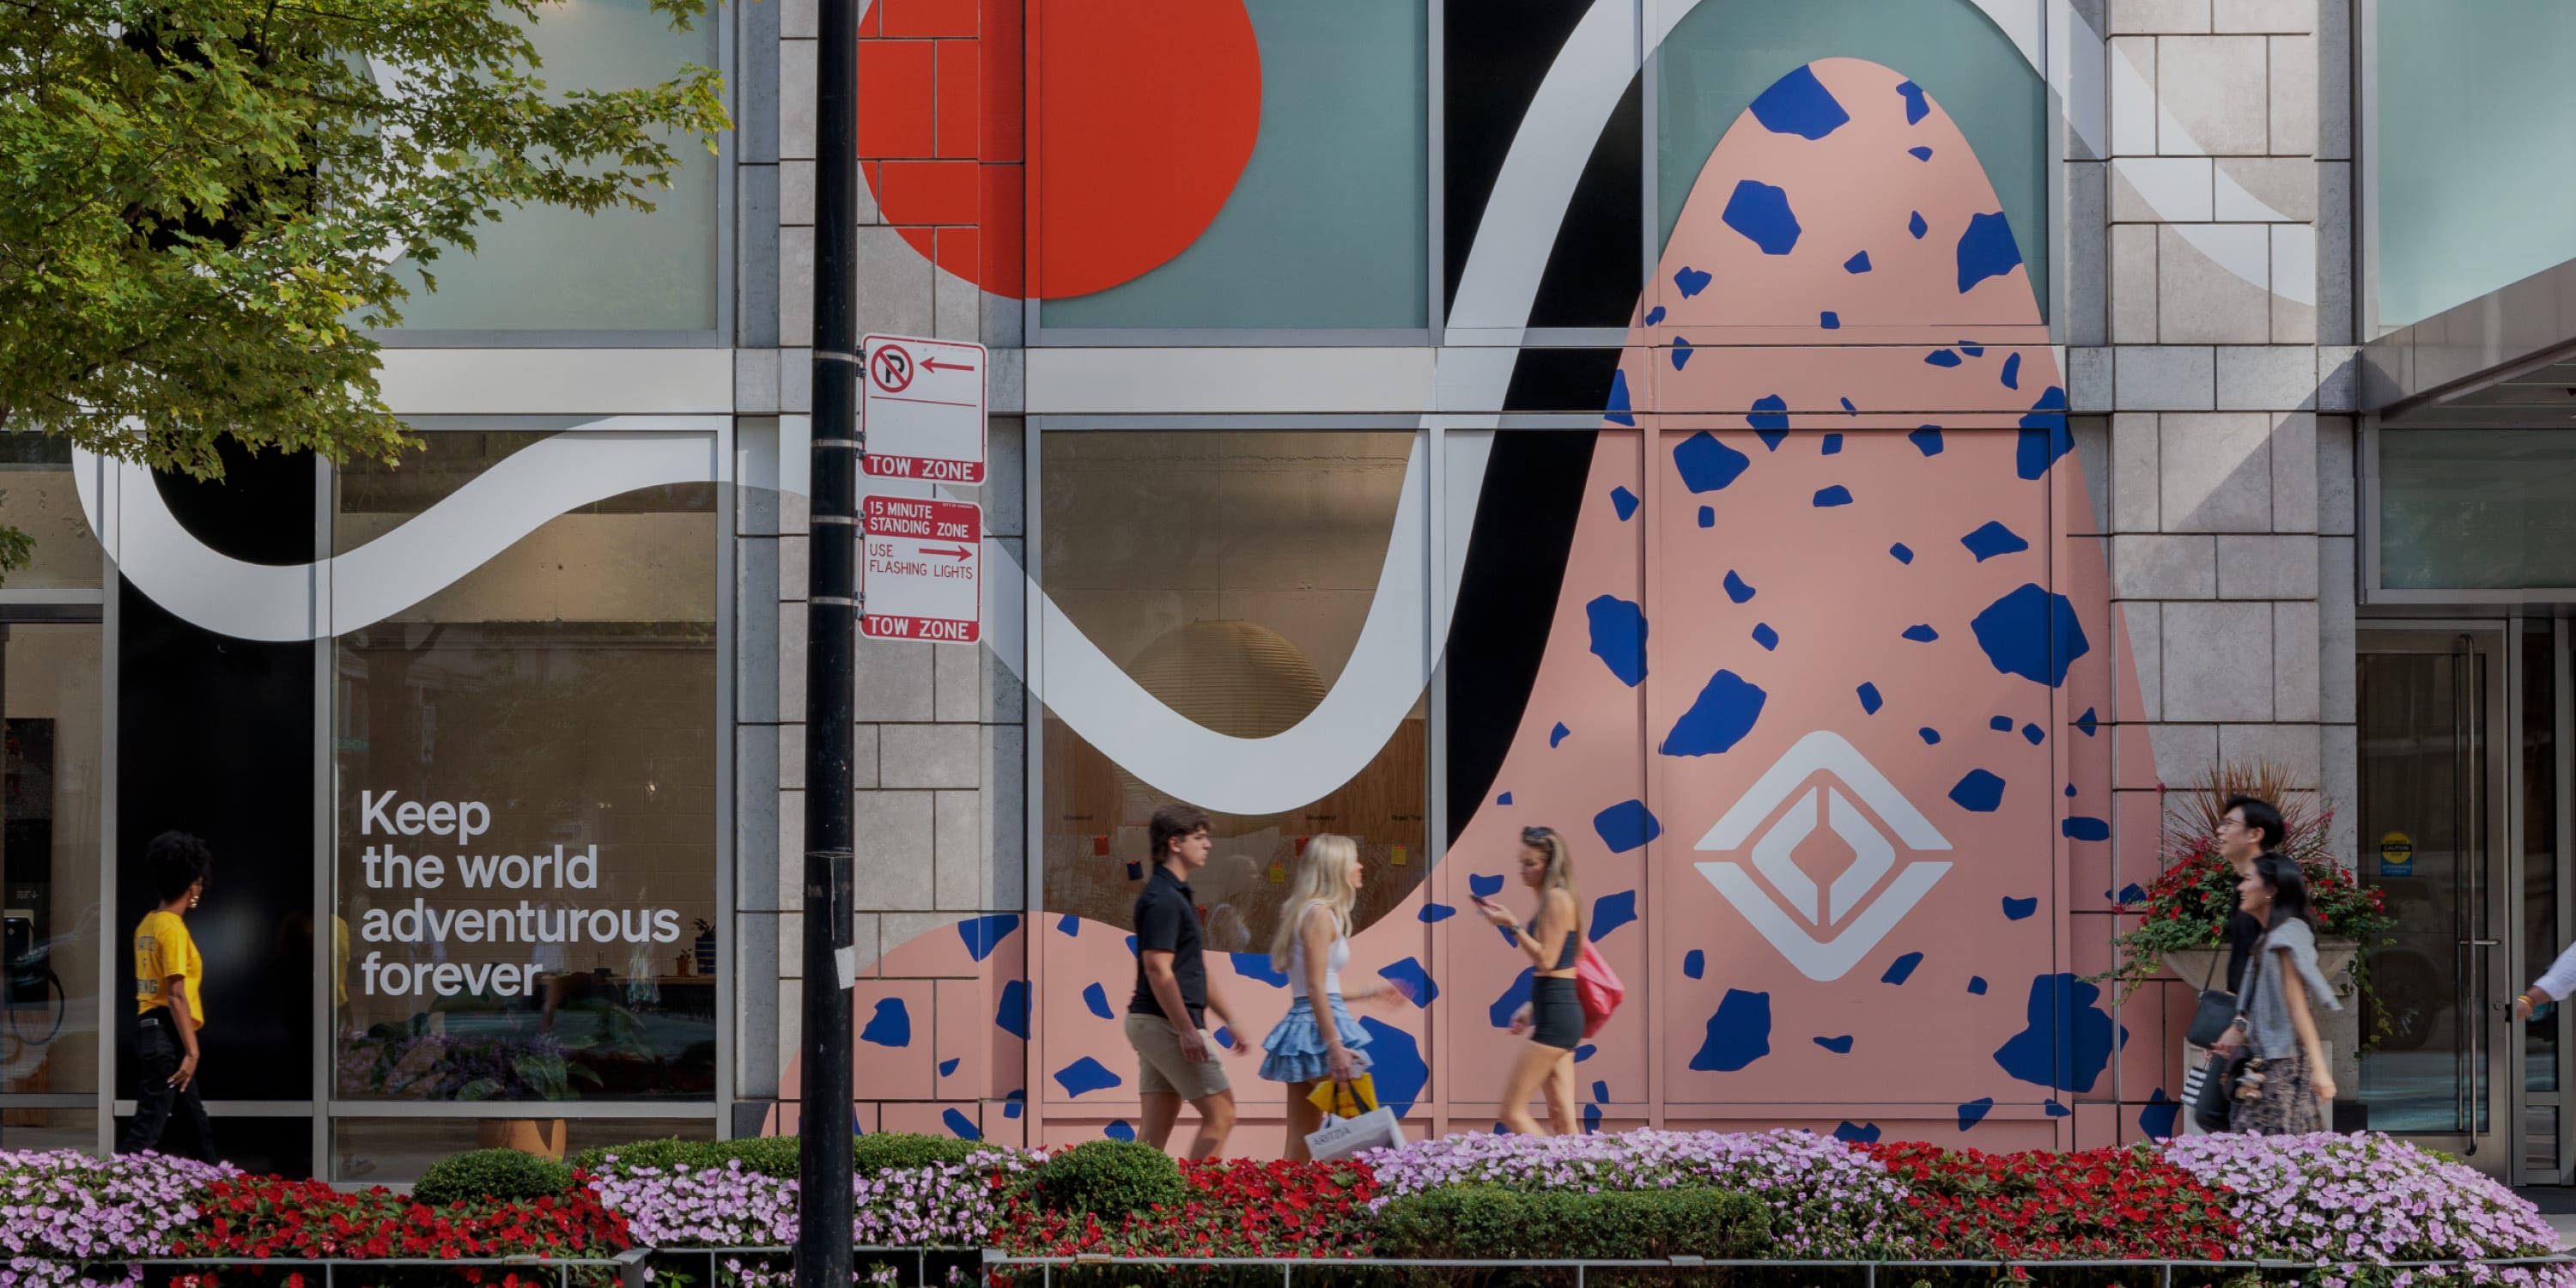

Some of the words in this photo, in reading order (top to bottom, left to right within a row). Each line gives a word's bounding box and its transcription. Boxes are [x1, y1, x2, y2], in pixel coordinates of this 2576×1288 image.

[870, 456, 911, 476] TOW
[922, 459, 974, 481] ZONE
[870, 501, 884, 514] 15
[888, 502, 933, 519] MINUTE
[870, 517, 931, 535] STANDING
[937, 522, 969, 538] ZONE
[869, 544, 894, 557] USE
[869, 560, 927, 576] FLASHING
[934, 564, 973, 580] LIGHTS
[869, 617, 908, 636] TOW
[919, 620, 969, 640] ZONE
[361, 790, 491, 846] Keep
[361, 844, 445, 889] the
[457, 844, 598, 889] world
[361, 897, 680, 943] adventurous
[361, 951, 543, 996] forever
